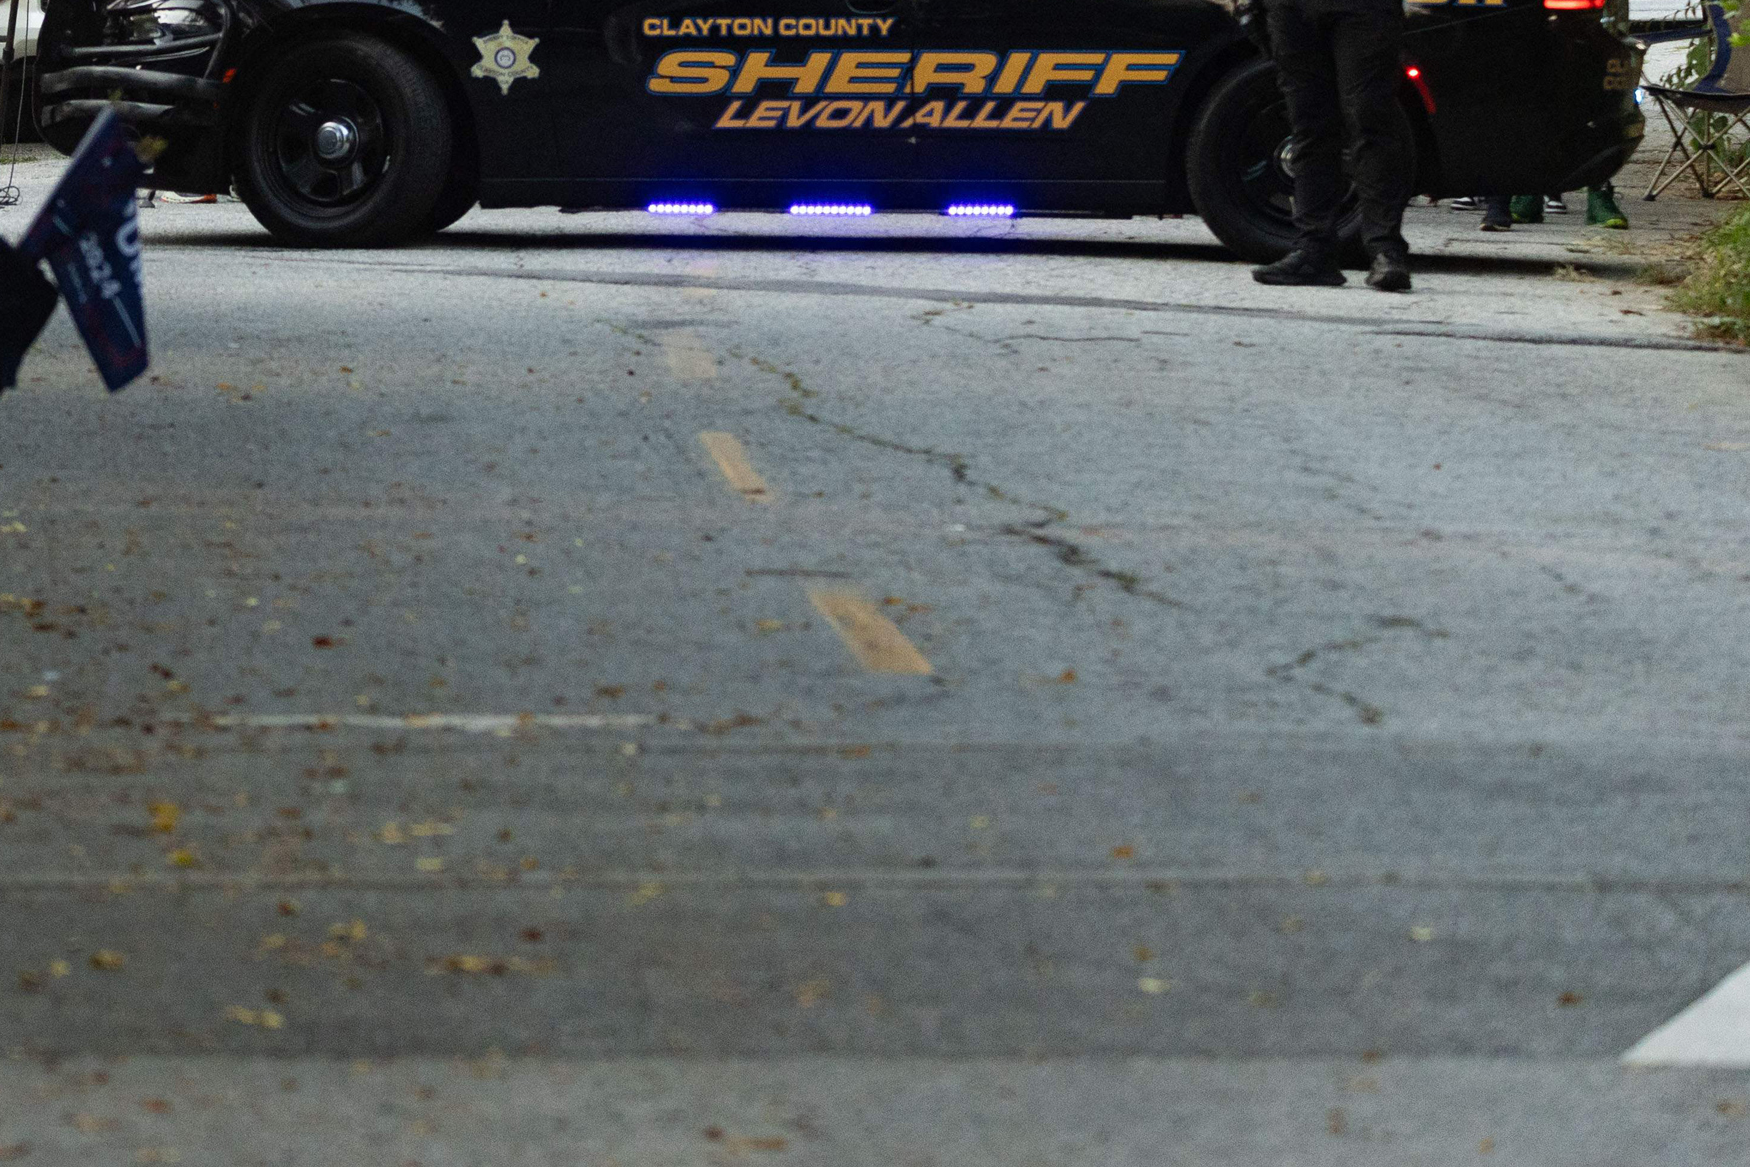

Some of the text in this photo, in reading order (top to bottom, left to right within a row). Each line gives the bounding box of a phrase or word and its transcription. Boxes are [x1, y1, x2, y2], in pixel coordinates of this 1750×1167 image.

[643, 17, 895, 37] CLAYTON COUNTY
[646, 48, 1186, 98] SHERIFF
[713, 99, 1090, 130] LEVON ALLEN
